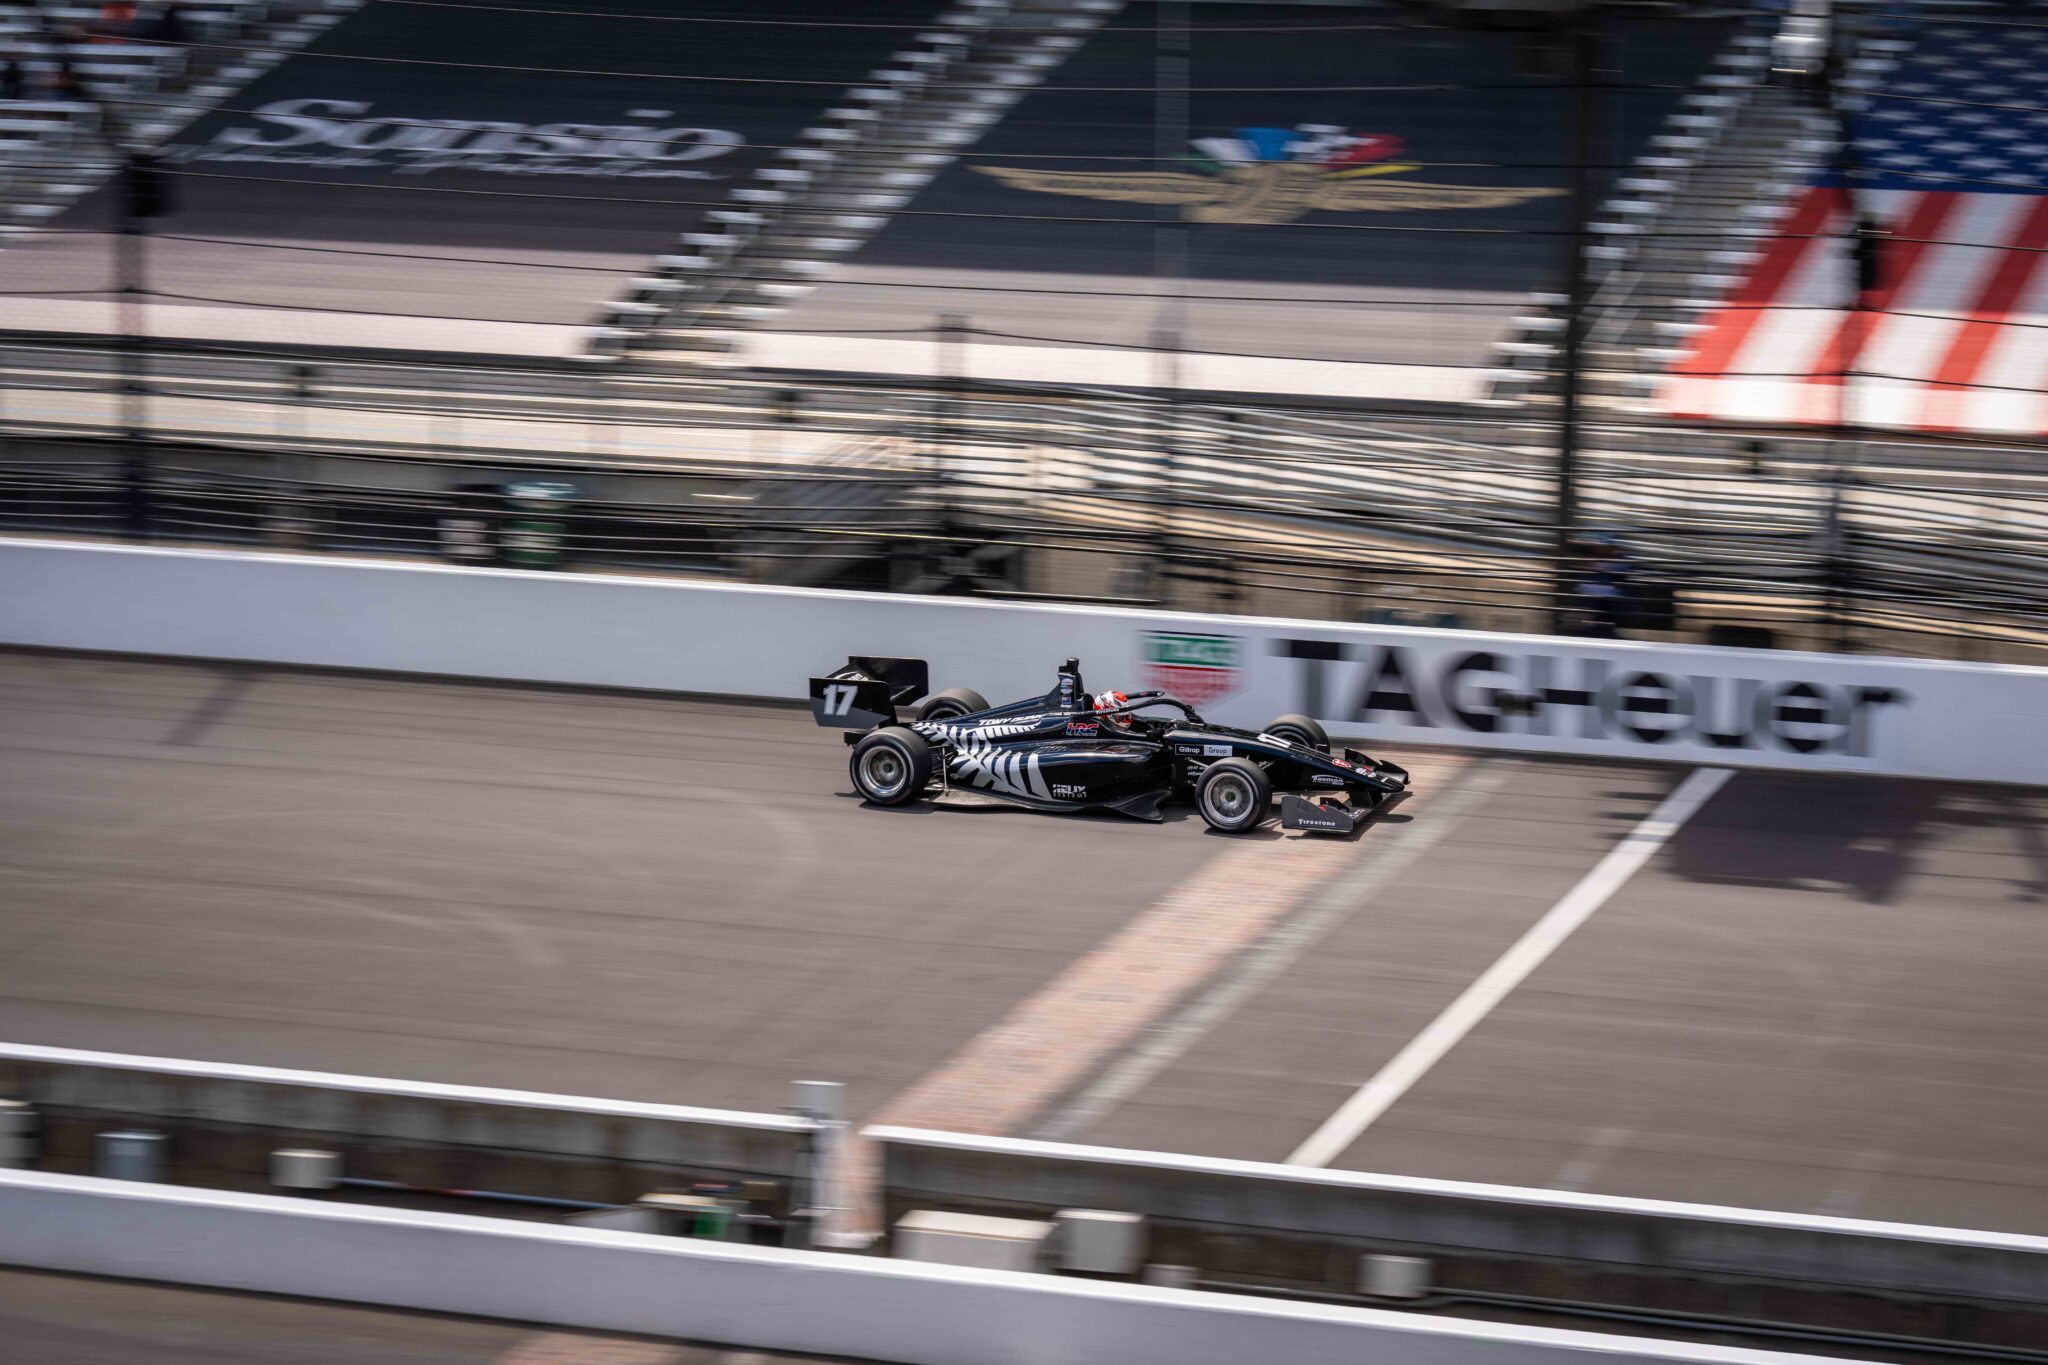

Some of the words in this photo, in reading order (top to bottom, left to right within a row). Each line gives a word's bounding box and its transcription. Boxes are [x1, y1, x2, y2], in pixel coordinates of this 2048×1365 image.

[211, 98, 746, 162] Sonsio
[823, 684, 858, 716] 17
[979, 718, 1012, 726] TONY
[1066, 722, 1100, 733] HRC
[1179, 746, 1200, 754] Giltrap
[1208, 747, 1228, 755] Group
[1053, 784, 1086, 793] HELIX
[1298, 818, 1336, 827] Firestone
